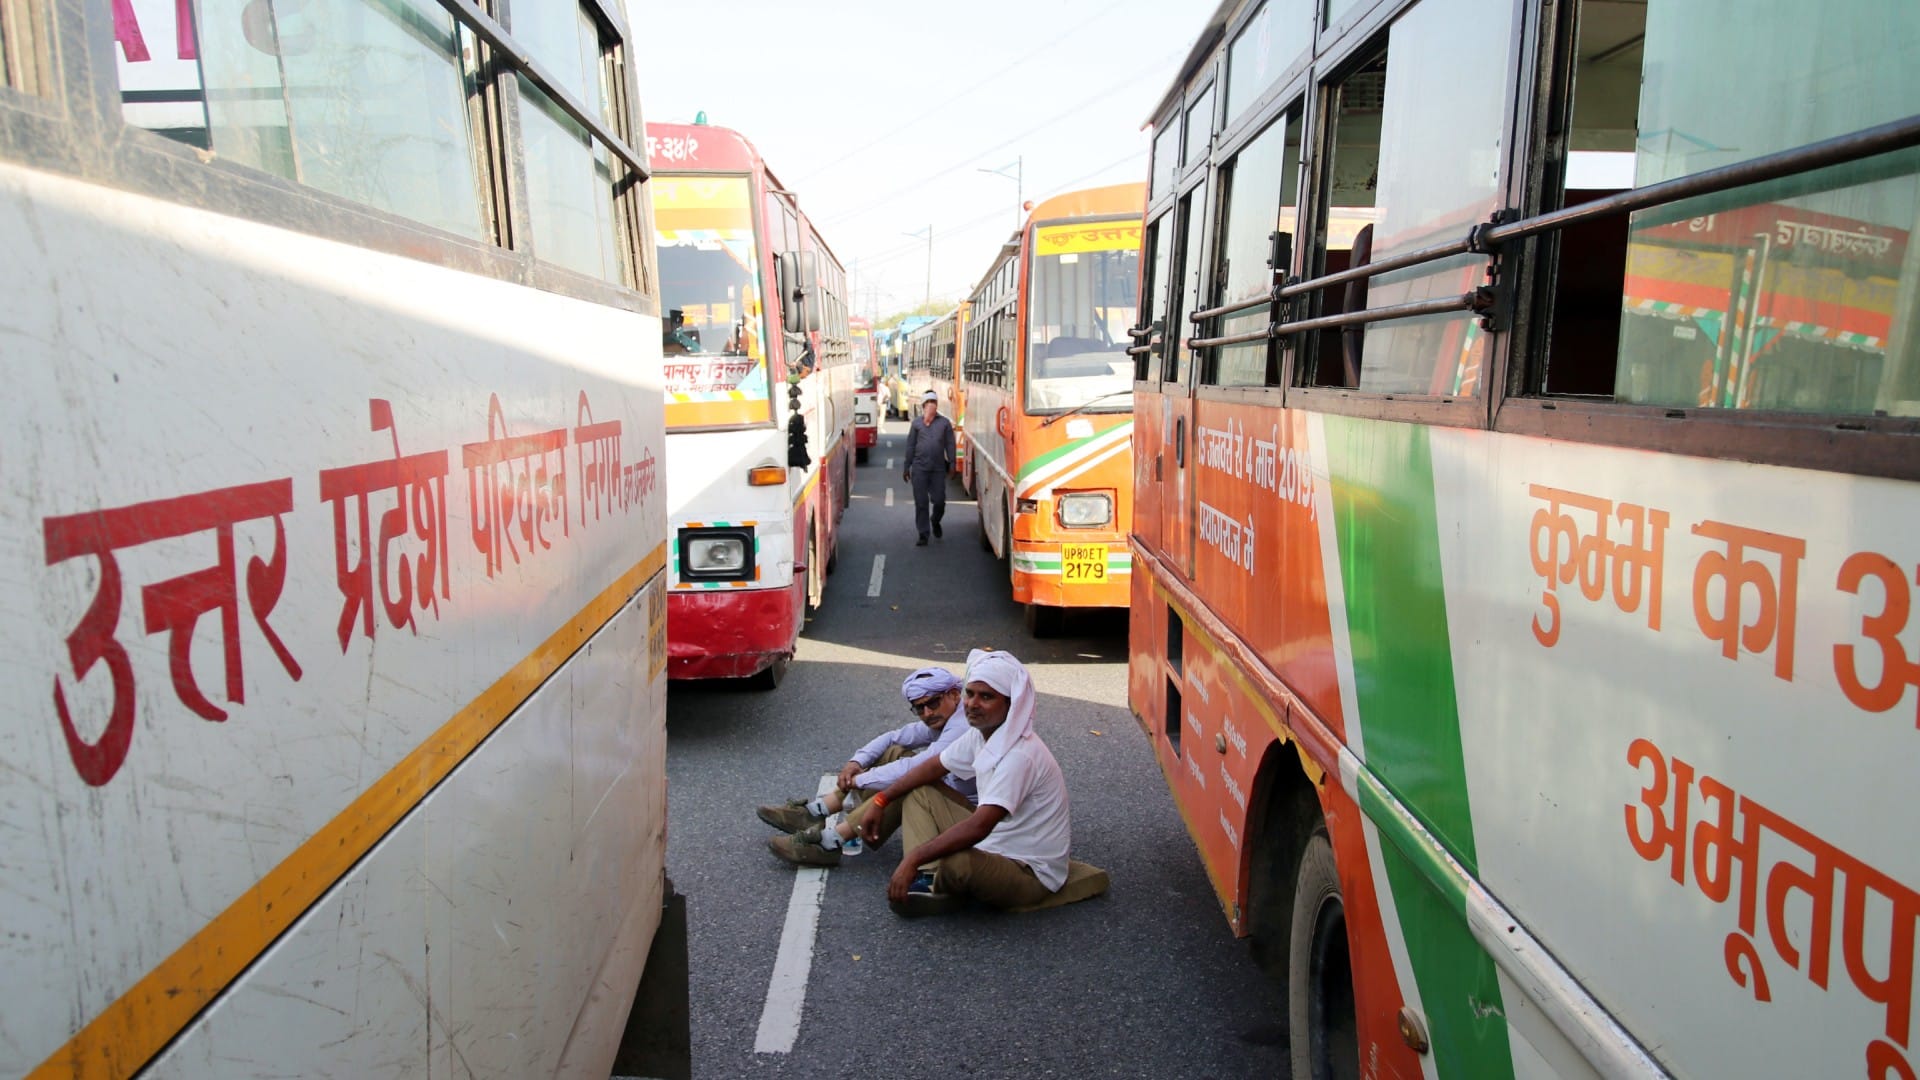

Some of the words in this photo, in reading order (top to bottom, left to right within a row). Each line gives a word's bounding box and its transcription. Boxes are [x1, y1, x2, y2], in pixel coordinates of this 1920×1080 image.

[1207, 417, 1233, 475] जनवरी
[1246, 436, 1253, 483] 4
[1255, 423, 1278, 492] मार्च
[1066, 562, 1104, 579] 2179
[1200, 500, 1242, 567] प्रयागराज
[43, 477, 302, 788] उत्तर
[319, 398, 451, 656] प्रदेश
[462, 392, 568, 578] परिवहन
[574, 389, 622, 529] निगम
[1529, 483, 1670, 648] कुम्भ
[1691, 519, 1806, 682] का
